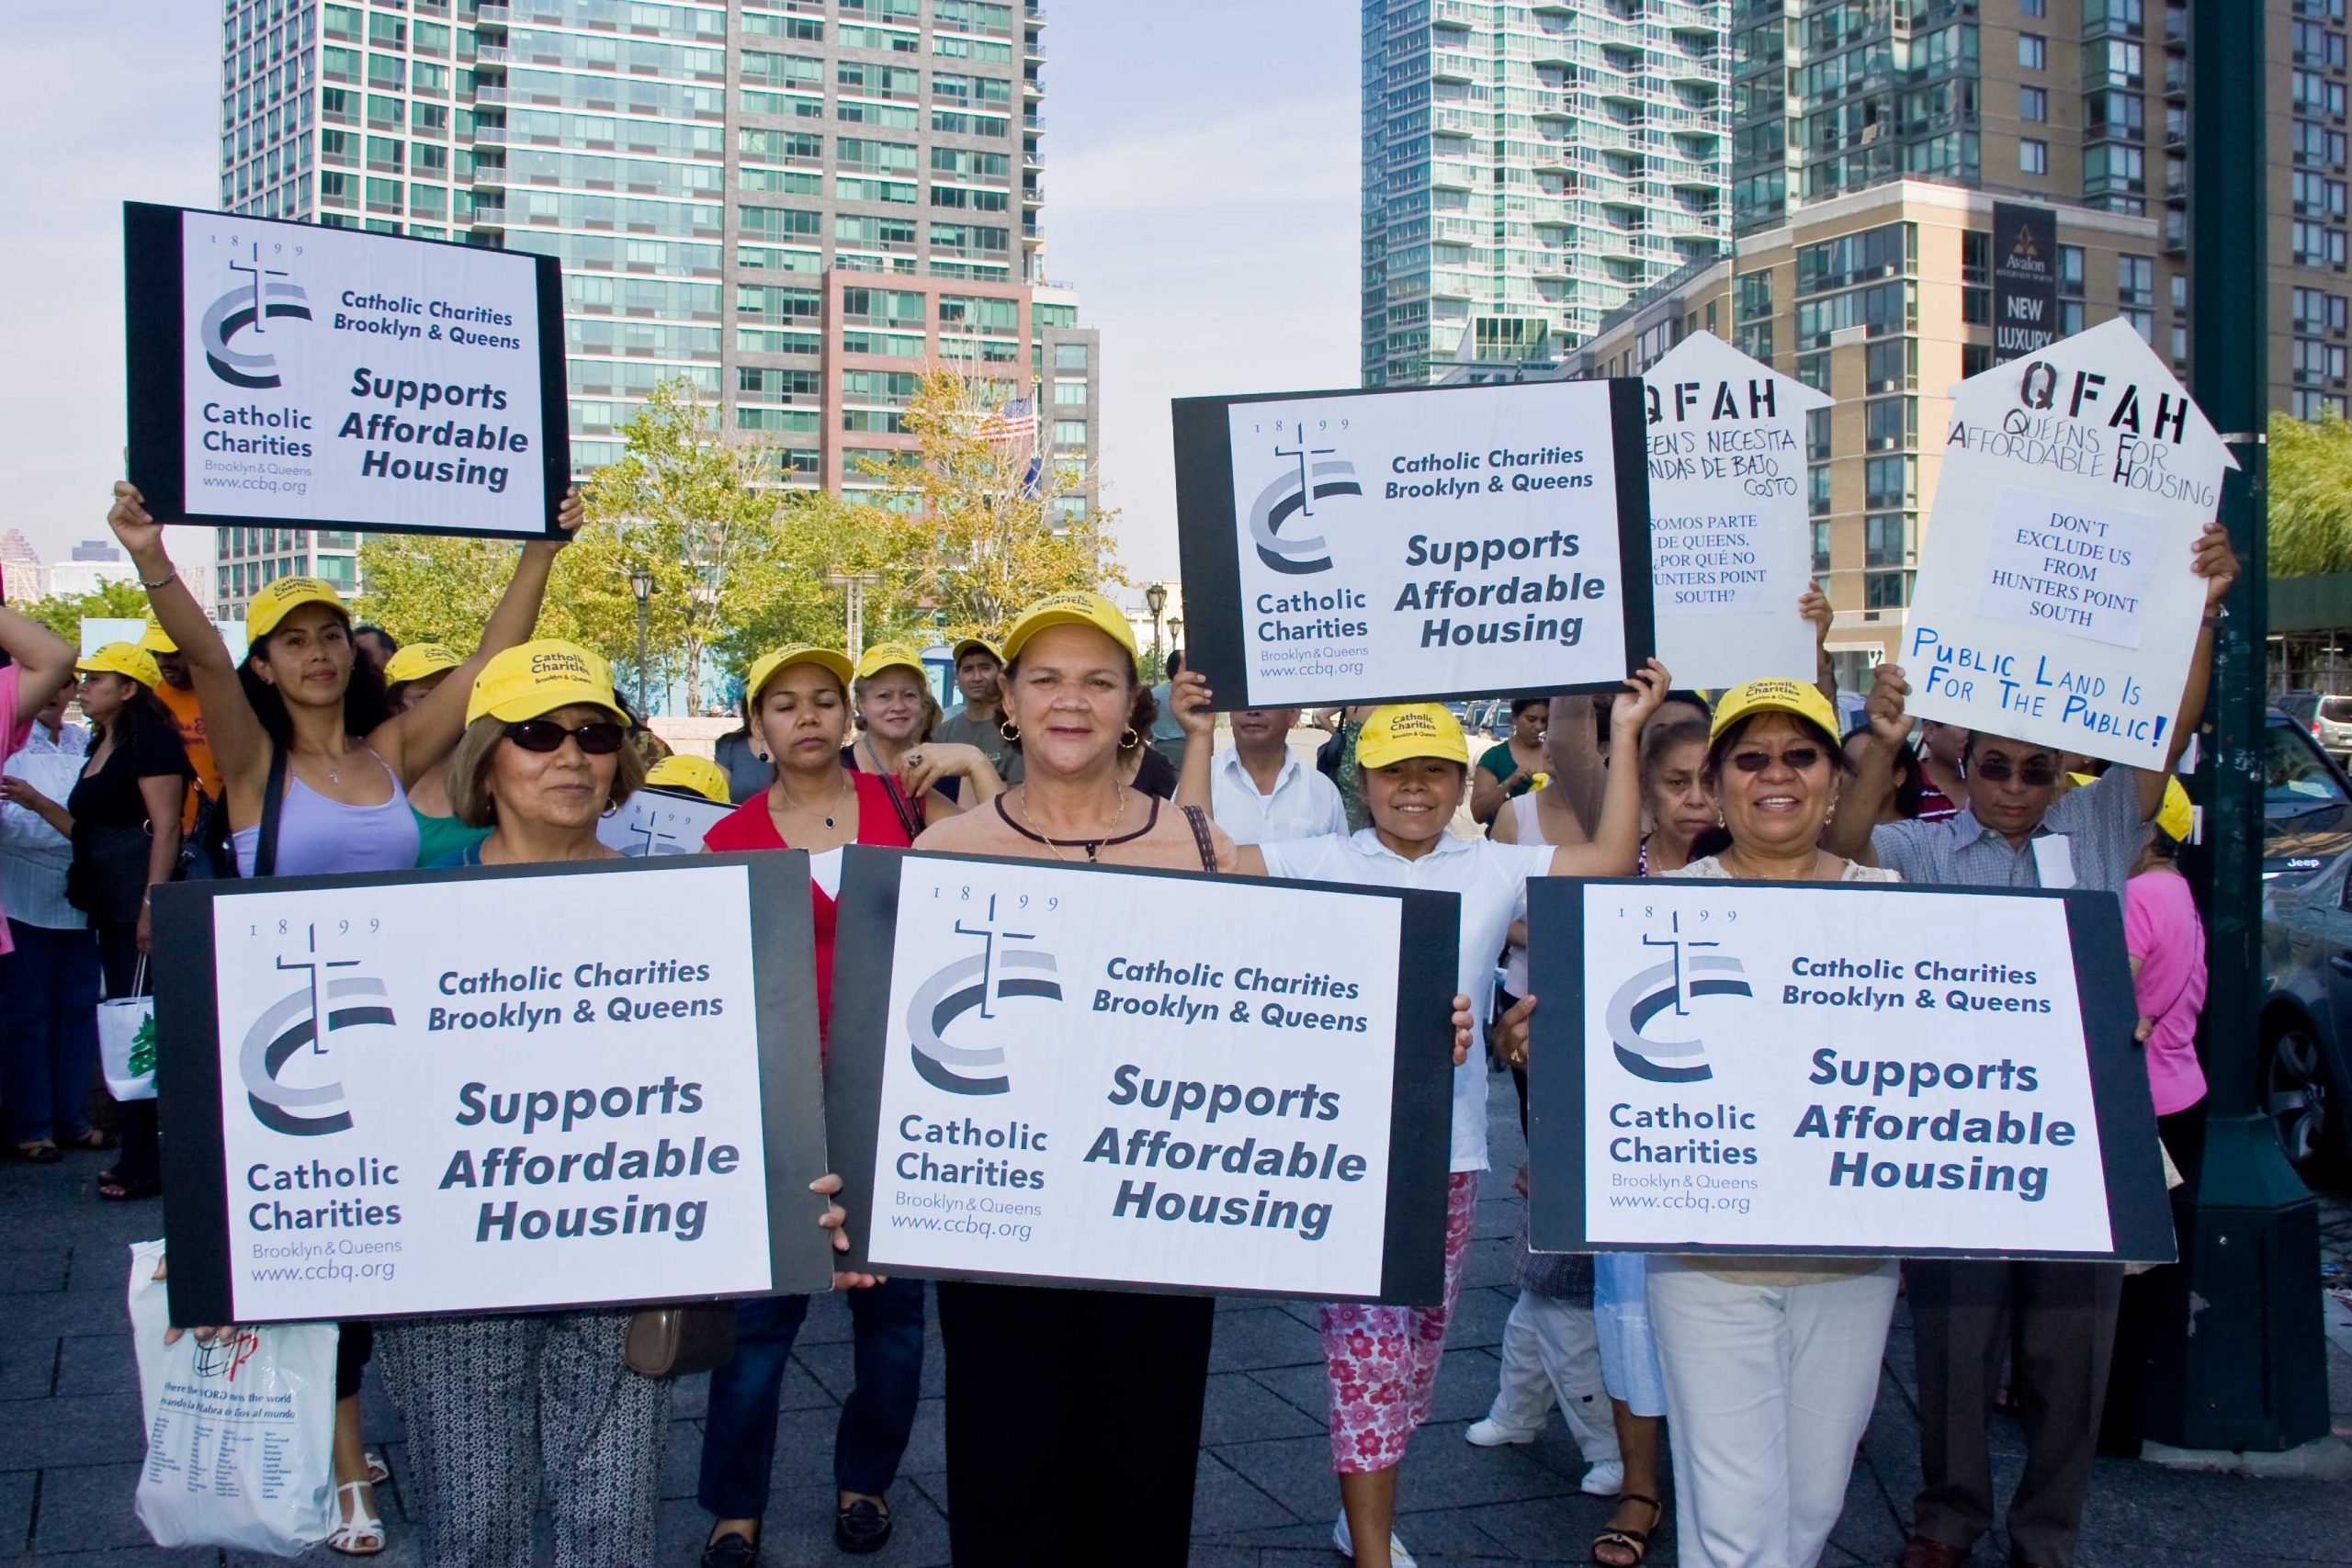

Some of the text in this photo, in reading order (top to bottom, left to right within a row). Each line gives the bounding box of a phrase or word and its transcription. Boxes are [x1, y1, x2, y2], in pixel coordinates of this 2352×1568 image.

[2007, 254, 2044, 272] Avalon
[342, 291, 512, 326] Catholic Charities
[2007, 295, 2043, 321] NEW
[334, 313, 519, 349] Brooklyn & Queens
[1997, 325, 2052, 351] LUXURY
[351, 367, 506, 410] Supports
[204, 403, 311, 429] Catholic
[204, 431, 311, 457] Charities
[338, 412, 528, 453] Affordable
[1707, 429, 1797, 453] NECESITA
[2003, 408, 2168, 471] QUEENS FOR
[362, 450, 508, 493] Housing
[1393, 446, 1583, 473] Catholic Charities
[1701, 457, 1726, 479] DE
[1730, 454, 1778, 478] BAJO
[1947, 421, 2214, 508] AFFORDABLE HOUSING
[204, 476, 307, 495] www.ccbq.org
[1385, 474, 1592, 499] Brooklyn & Queens
[1744, 477, 1797, 497] COSTO
[1649, 514, 1758, 530] SOMOS PARTE
[2050, 513, 2109, 537] DON'T
[1406, 530, 1579, 571] Supports
[1657, 534, 1749, 549] DE QUEENS,
[2016, 529, 2132, 567] EXCLUDE US
[1653, 549, 1755, 570] ¿POR QUÉ NO
[2043, 557, 2097, 581] FROM
[1394, 573, 1604, 611] Affordable
[1654, 570, 1766, 586] UNTERS POINT
[1992, 570, 2138, 614] HUNTERS POINT
[1257, 589, 1365, 614] Catholic
[1675, 589, 1736, 604] SOUTH?
[2030, 600, 2093, 627] SOUTH
[1259, 618, 1367, 641] Charities
[1421, 614, 1583, 648] Housing
[1261, 660, 1363, 677] www.ccbq.org
[2035, 655, 2106, 697] LAND
[1926, 666, 1973, 702] FOR
[1999, 680, 2046, 716] THE
[1390, 720, 1436, 731] Charities
[1392, 713, 1433, 724] Catholic
[2288, 858, 2320, 868] Jeep
[439, 959, 709, 995] Catholic Charities
[1107, 957, 1358, 998] Catholic Charities
[1792, 957, 2036, 985] Catholic Charities
[1092, 989, 1367, 1032] Brooklyn & Queens
[1783, 986, 2051, 1013] Brooklyn & Queens
[428, 997, 722, 1032] Brooklyn & Queens
[1809, 1048, 2038, 1097] Supports
[456, 1077, 702, 1134] Supports
[1108, 1065, 1340, 1122] Supports
[1610, 1103, 1756, 1129] Catholic
[1793, 1105, 2075, 1145] Affordable
[900, 1115, 1047, 1151] Catholic
[438, 1137, 739, 1190] Affordable
[1083, 1127, 1366, 1181] Affordable
[1610, 1137, 1757, 1164] Charities
[248, 1157, 399, 1191] Catholic
[897, 1153, 1044, 1190] Charities
[1829, 1152, 2048, 1201] Housing
[249, 1199, 401, 1231] Charities
[1113, 1179, 1332, 1240] Housing
[1610, 1190, 1750, 1213] www.ccbq.org
[476, 1194, 707, 1242] Housing
[892, 1214, 1031, 1242] www.ccbq.org
[252, 1258, 394, 1282] www.ccbq.org
[253, 1408, 263, 1417] al
[264, 1409, 295, 1419] mundo
